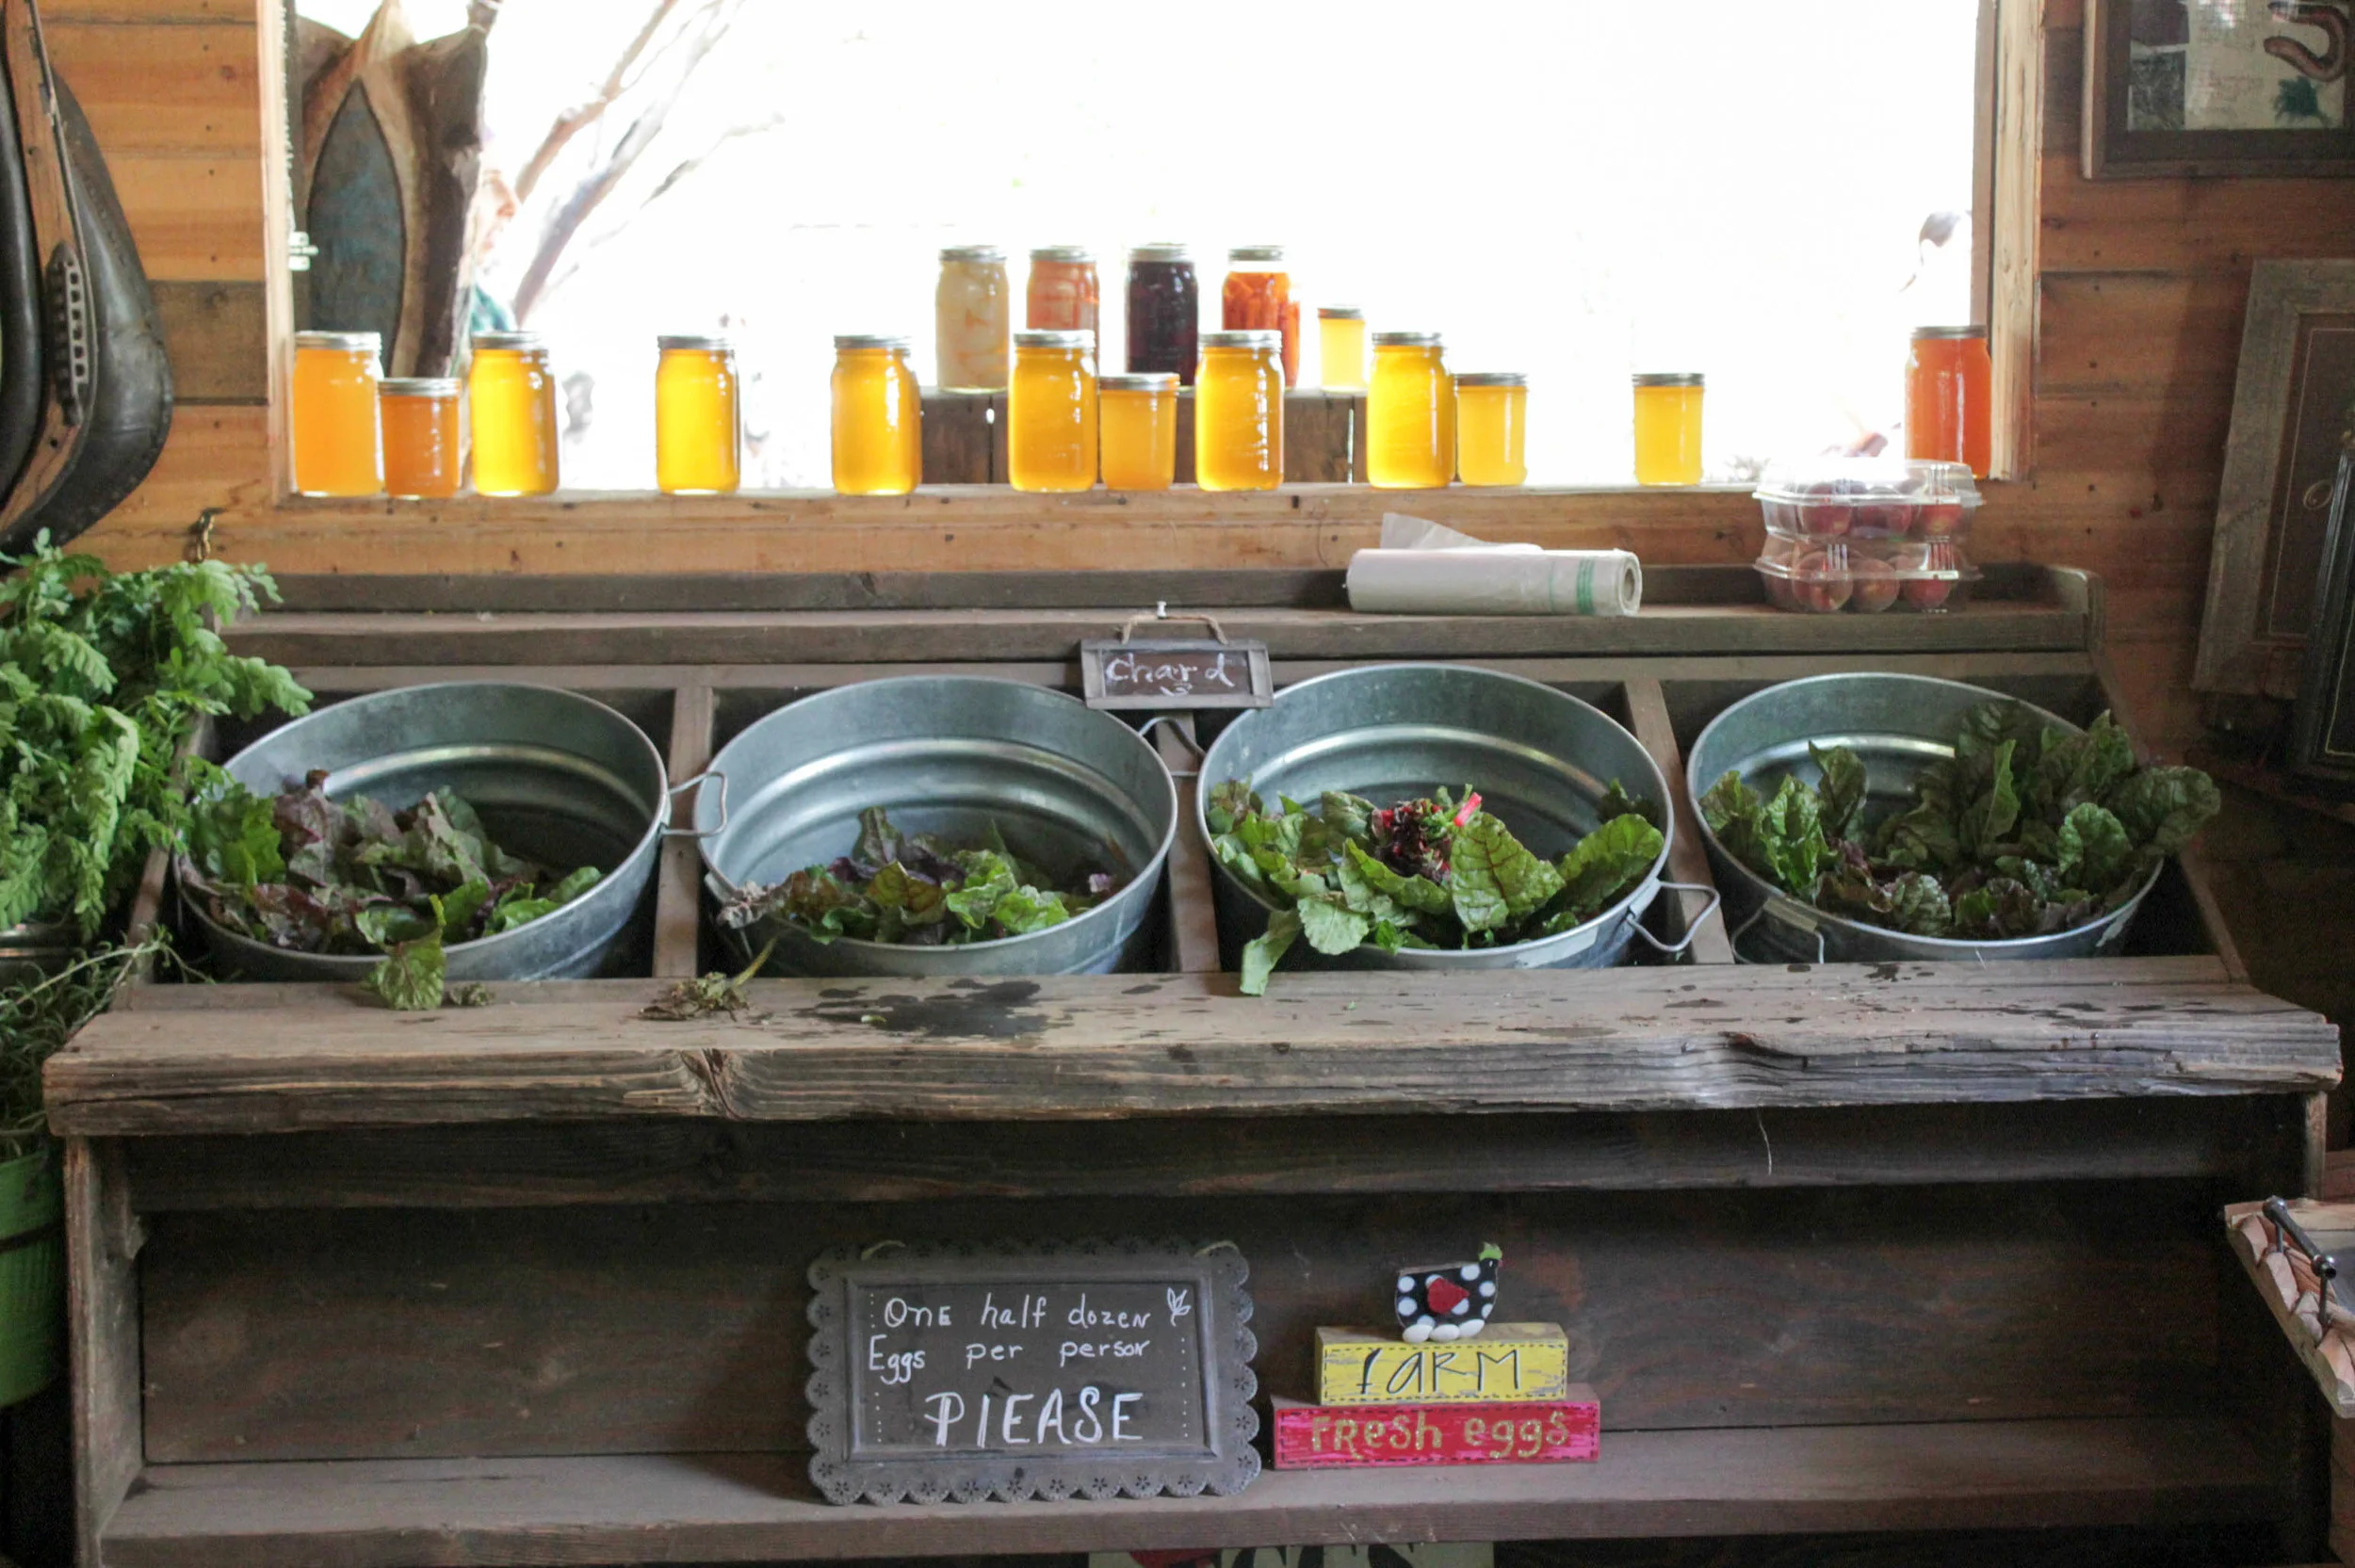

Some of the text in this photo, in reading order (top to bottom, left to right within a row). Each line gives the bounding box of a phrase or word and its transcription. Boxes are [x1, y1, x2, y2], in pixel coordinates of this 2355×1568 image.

[1105, 652, 1236, 687] Chard
[981, 1292, 1048, 1330] half
[869, 1334, 1150, 1385] Eggs per person
